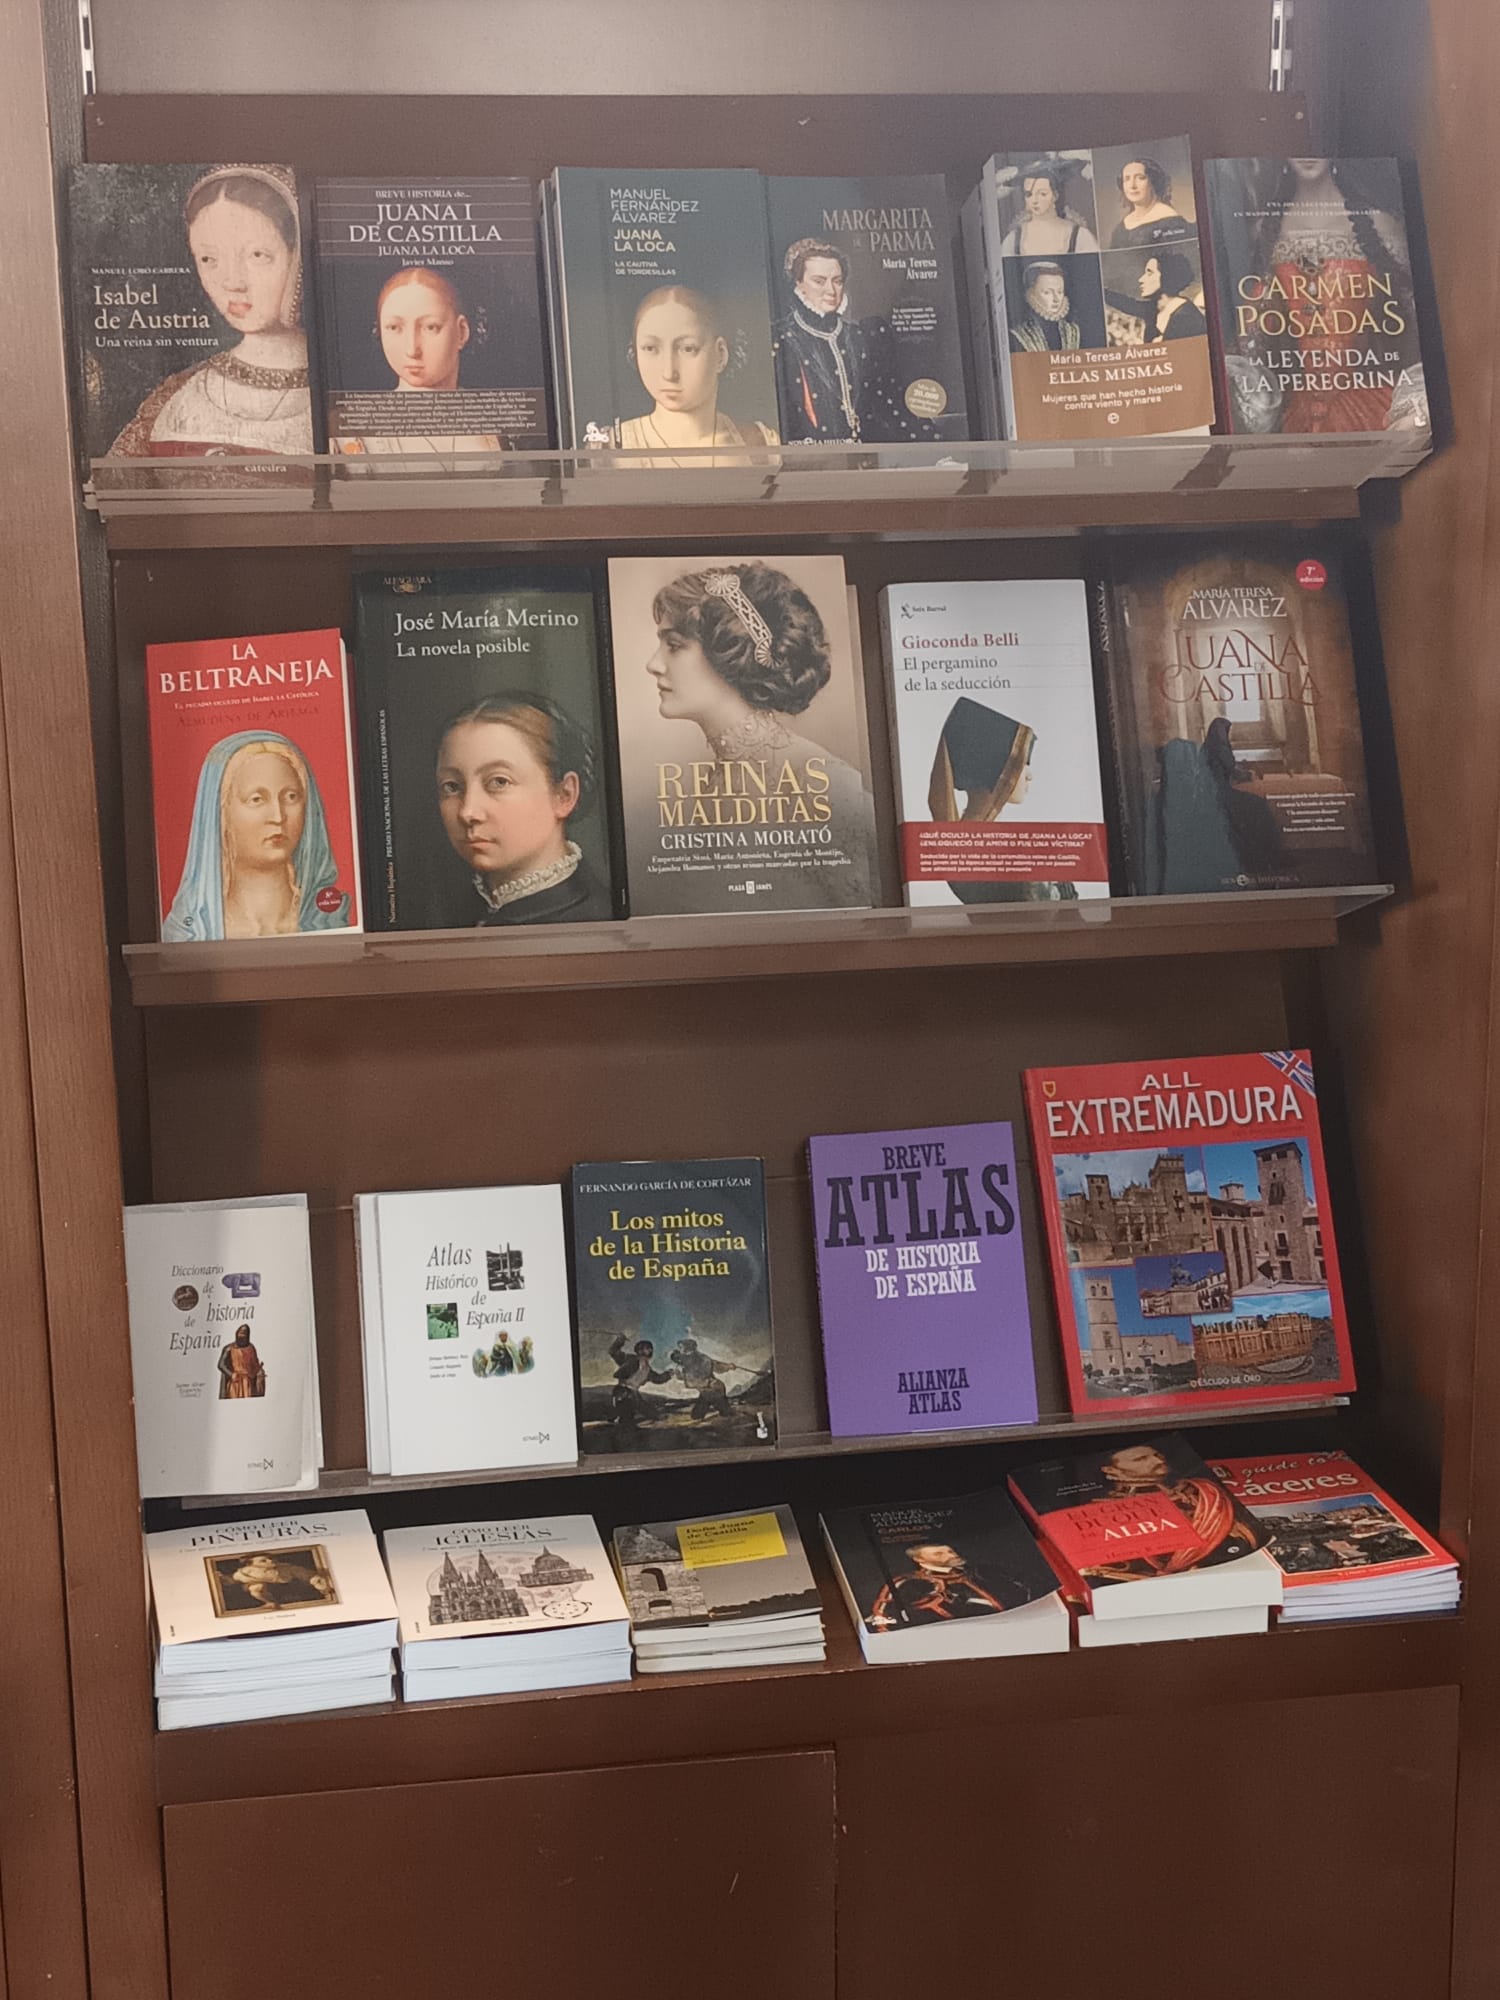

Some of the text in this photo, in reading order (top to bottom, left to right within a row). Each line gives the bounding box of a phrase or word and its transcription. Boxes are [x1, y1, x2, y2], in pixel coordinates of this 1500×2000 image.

[375, 190, 452, 199] BREVE HISTORIA
[610, 188, 672, 201] MANUEL
[377, 203, 473, 225] JUANA I
[611, 198, 700, 213] FERNÁNDEZ
[612, 210, 677, 224] ÁLVAREZ
[822, 207, 934, 232] MARGARITA
[349, 224, 503, 243] DE CASTILLA
[614, 229, 662, 241] JUANA
[870, 230, 936, 252] PARMA
[378, 245, 476, 257] JUANA LA LOCA
[614, 241, 677, 252] LA LOCA
[615, 260, 659, 268] LA CAUTIVA
[615, 268, 677, 276] DE TORDESILLAS
[909, 257, 937, 268] Teresa
[94, 281, 159, 305] Isabel
[1238, 272, 1393, 305] CARMEN
[94, 308, 211, 329] de Austria
[1236, 300, 1405, 338] POSADAS
[96, 336, 219, 348] Una reina sin ventura
[1050, 346, 1168, 365] María Teresa Álvarez
[1250, 348, 1400, 369] LA LEYENDA DE
[1049, 362, 1173, 385] ELLAS MISMAS
[1242, 369, 1413, 393] LA PEREGRINA
[1042, 383, 1183, 404] Mujeres que han hecho historia
[1064, 402, 1093, 411] contra
[1095, 399, 1123, 409] viento
[1125, 400, 1131, 409] y
[1192, 586, 1274, 599] MARÍA TERESA
[394, 607, 579, 636] José María Merino
[397, 637, 531, 659] La novela posible
[902, 632, 1020, 649] Gioconda Belli
[232, 642, 259, 661] LA
[1173, 627, 1308, 681] JUANA
[904, 656, 998, 674] El pergamino
[160, 658, 335, 694] BELTRANEJA
[905, 674, 1011, 691] de la seducción
[1160, 663, 1323, 706] CASTILLA
[656, 757, 832, 799] REINAS
[658, 795, 833, 828] MALDITAS
[661, 825, 833, 850] CRISTINA MORATÓ
[1030, 832, 1056, 840] JUANA
[1141, 1071, 1202, 1091] ALL
[1045, 1084, 1303, 1137] EXTREMADURA
[882, 1143, 947, 1170] BREVE
[580, 1176, 752, 1193] FERNANDO GARCÍA DE CORTÁZAR
[824, 1163, 1016, 1248] ATLAS
[609, 1208, 724, 1231] Los mitos
[589, 1230, 748, 1256] de la Historia
[426, 1242, 473, 1267] Atlas
[865, 1241, 982, 1272] DE HISTORIA
[171, 1263, 225, 1277] Diccionario
[608, 1257, 731, 1282] de España
[202, 1281, 215, 1294] de
[425, 1273, 479, 1291] Histórico
[875, 1265, 977, 1299] DE ESPAÑA
[471, 1290, 487, 1306] de
[184, 1315, 196, 1328] de
[206, 1302, 255, 1322] historia
[465, 1308, 512, 1329] España
[169, 1330, 222, 1356] España
[897, 1367, 970, 1393] ALIANZA
[1197, 1374, 1262, 1387] ESCUDO DE ORO
[908, 1390, 962, 1415] ATLAS
[1241, 1460, 1300, 1478] guide
[191, 1523, 327, 1546] PINTURAS
[262, 1520, 299, 1530] LEER
[704, 1526, 748, 1537] Castilla
[719, 1520, 755, 1530] Juana
[1103, 1518, 1180, 1542] ALBA
[435, 1528, 552, 1545] IGLESIAS
